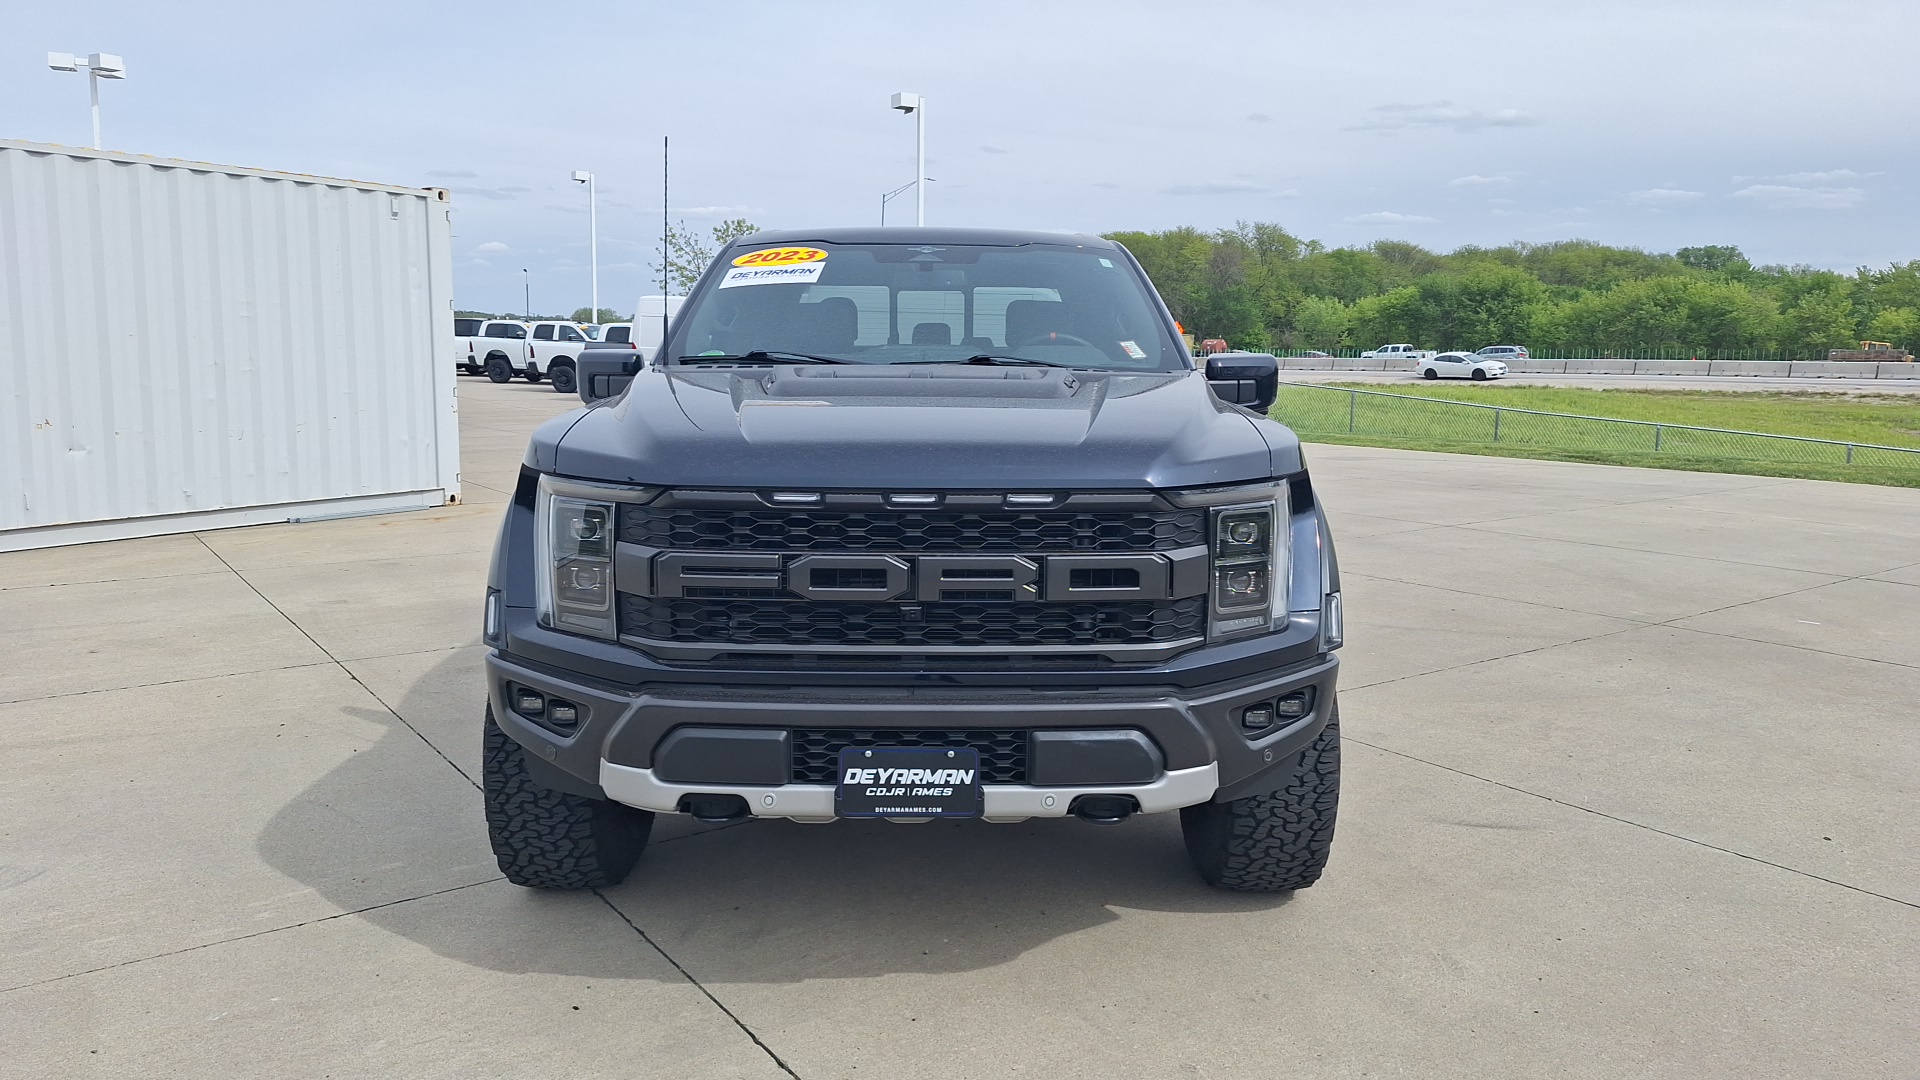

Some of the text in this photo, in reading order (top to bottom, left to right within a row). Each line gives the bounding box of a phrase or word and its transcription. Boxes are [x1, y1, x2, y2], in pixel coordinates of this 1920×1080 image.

[742, 250, 819, 265] 2023
[730, 268, 817, 280] DEYARMAN
[655, 553, 1170, 601] FORD
[843, 768, 975, 785] DEYARMAN
[866, 787, 953, 796] CDJR AMES
